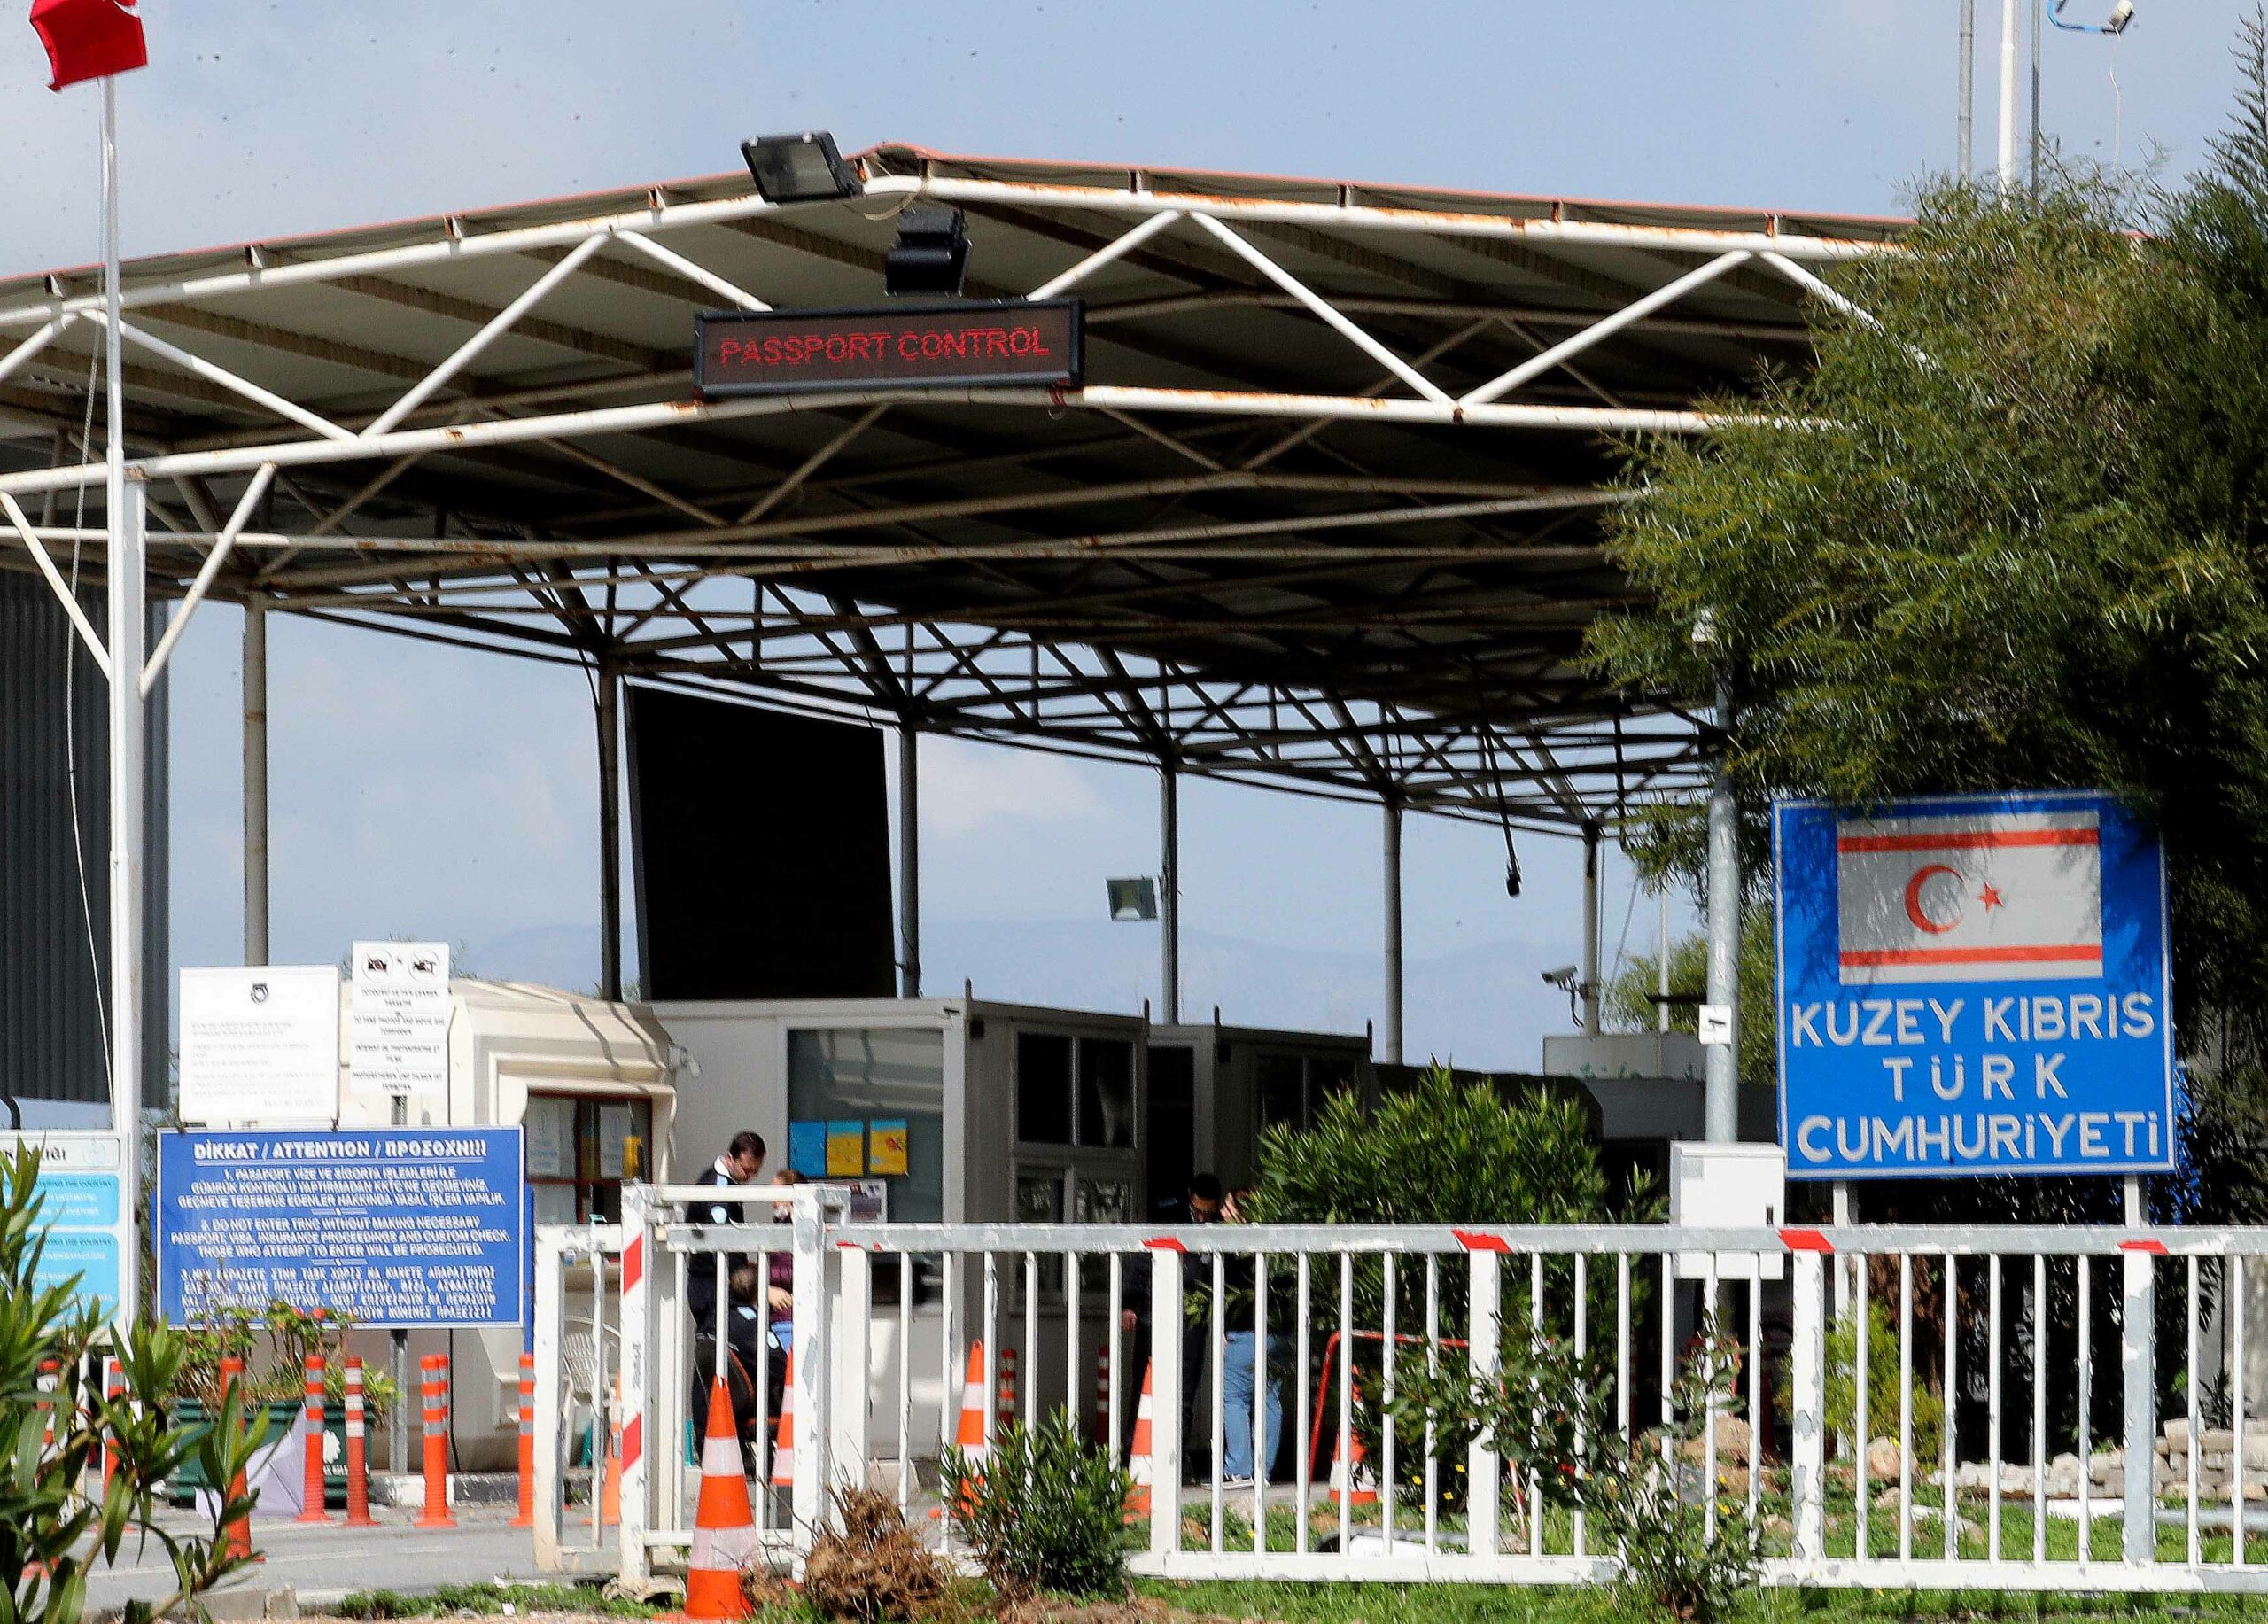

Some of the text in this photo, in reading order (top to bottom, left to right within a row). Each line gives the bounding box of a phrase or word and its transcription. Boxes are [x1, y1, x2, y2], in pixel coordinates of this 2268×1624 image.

[720, 325, 1051, 366] PASSPORT CONTROL
[1792, 992, 2155, 1047] KUZEY KIBRIS
[1883, 1052, 2068, 1101] TÜRK
[194, 1139, 259, 1160] DİKKAT
[272, 1140, 370, 1159] ATTENTION
[212, 1218, 229, 1231] DO
[230, 1218, 253, 1231] NOT
[254, 1217, 291, 1231] ENTER
[321, 1216, 370, 1230] WITHOUT
[372, 1216, 416, 1230] MAKING
[416, 1215, 480, 1229] NECESSARY
[257, 1231, 320, 1245] INSURANCE
[320, 1230, 398, 1244] PROCEEDINGS
[398, 1229, 422, 1243] AND
[423, 1229, 470, 1242] CUSTOM
[198, 1245, 234, 1258] THOSE
[235, 1245, 261, 1258] WHO
[262, 1244, 311, 1258] ATTEMPT
[312, 1244, 328, 1257] TO
[329, 1243, 365, 1256] ENTER
[366, 1243, 392, 1256] WILL
[392, 1242, 408, 1256] BE
